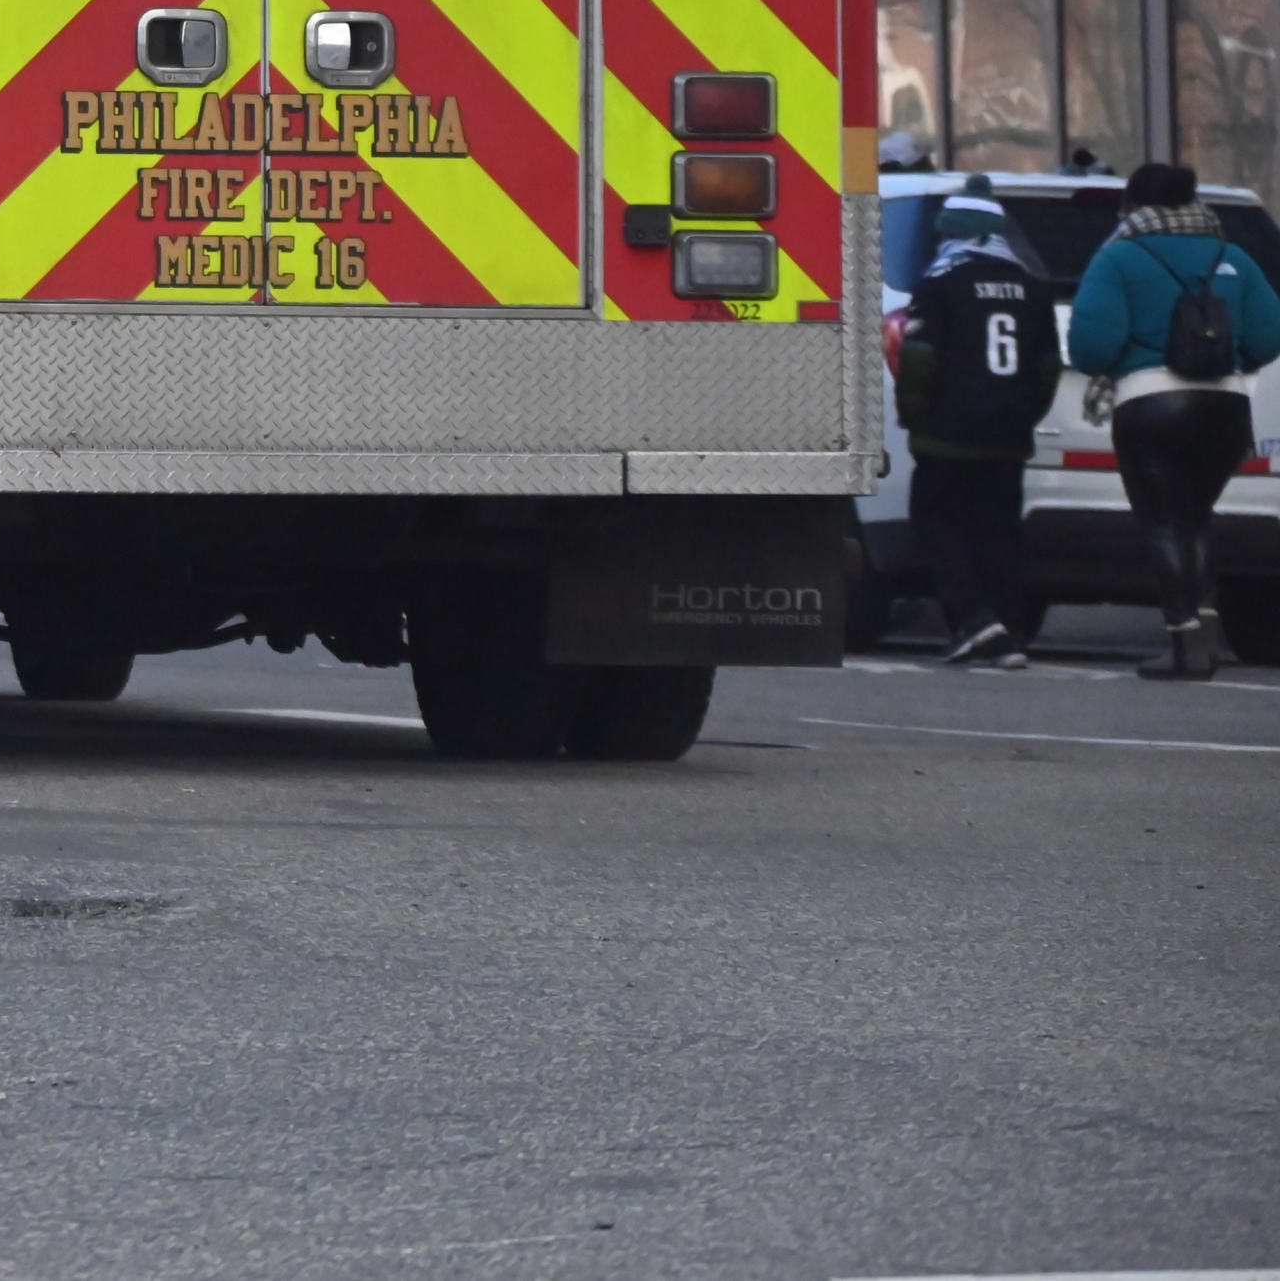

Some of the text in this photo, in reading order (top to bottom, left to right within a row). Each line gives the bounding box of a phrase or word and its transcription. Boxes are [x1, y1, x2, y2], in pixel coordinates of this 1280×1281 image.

[61, 91, 469, 158] PHILADELPHIA
[138, 168, 395, 223] FIRE DEPT.
[155, 235, 368, 289] MEDIC 16
[987, 312, 1018, 375] 6
[651, 583, 823, 611] Horton
